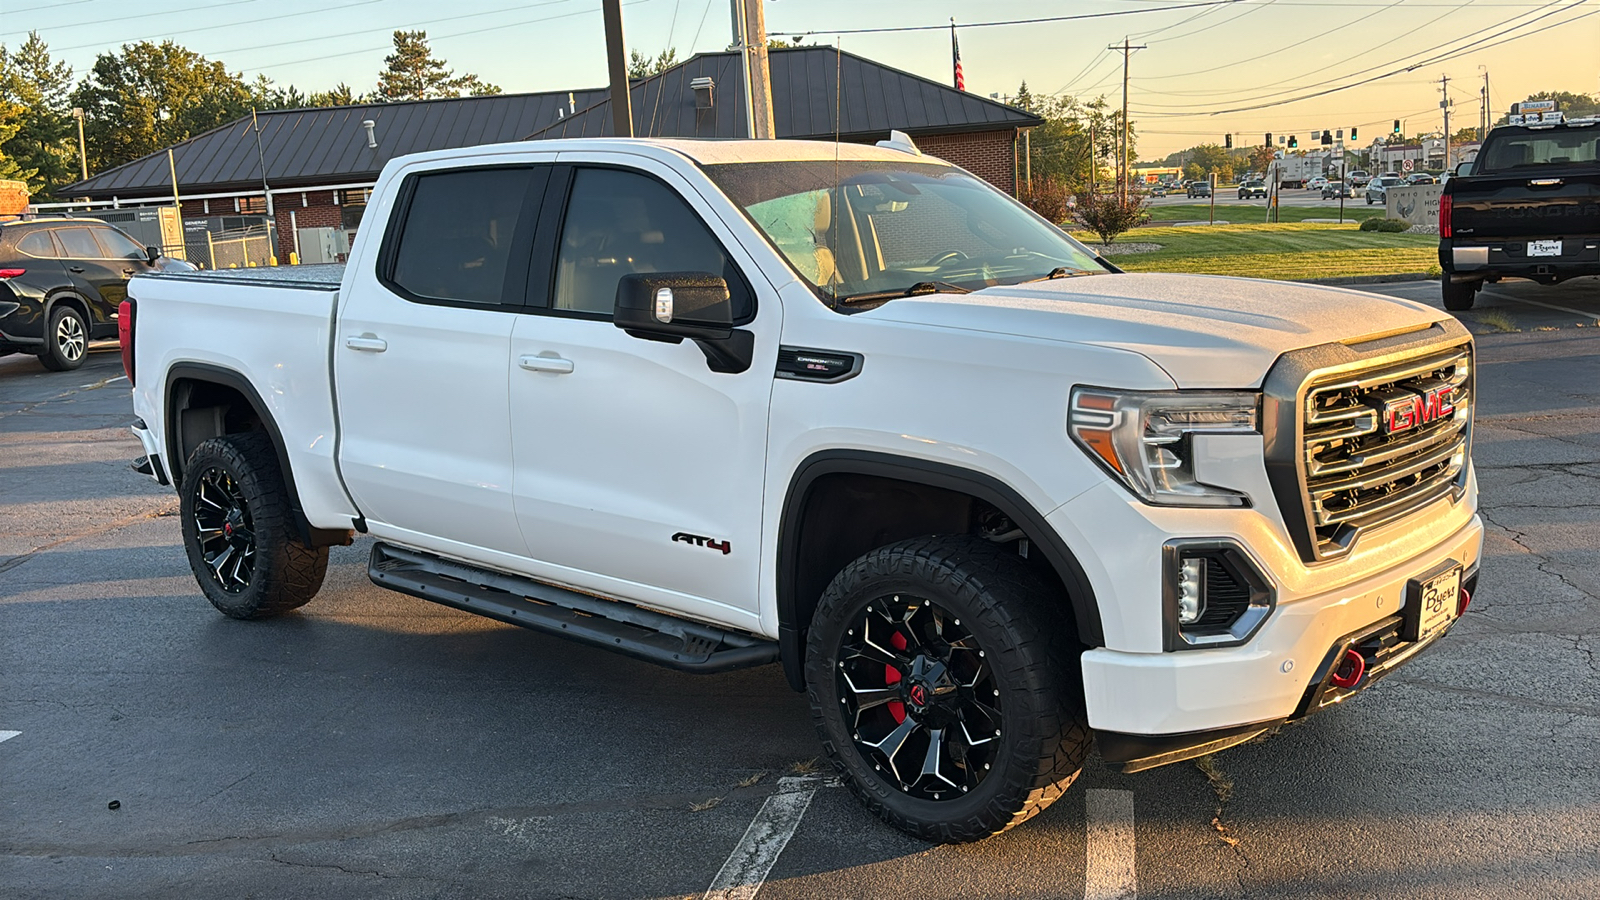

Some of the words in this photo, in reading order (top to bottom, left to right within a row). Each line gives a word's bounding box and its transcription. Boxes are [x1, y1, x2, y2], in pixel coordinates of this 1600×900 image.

[1490, 204, 1600, 218] TUNDRA
[1389, 385, 1453, 432] GMC
[671, 531, 731, 555] AT4
[1424, 586, 1455, 613] Byers
